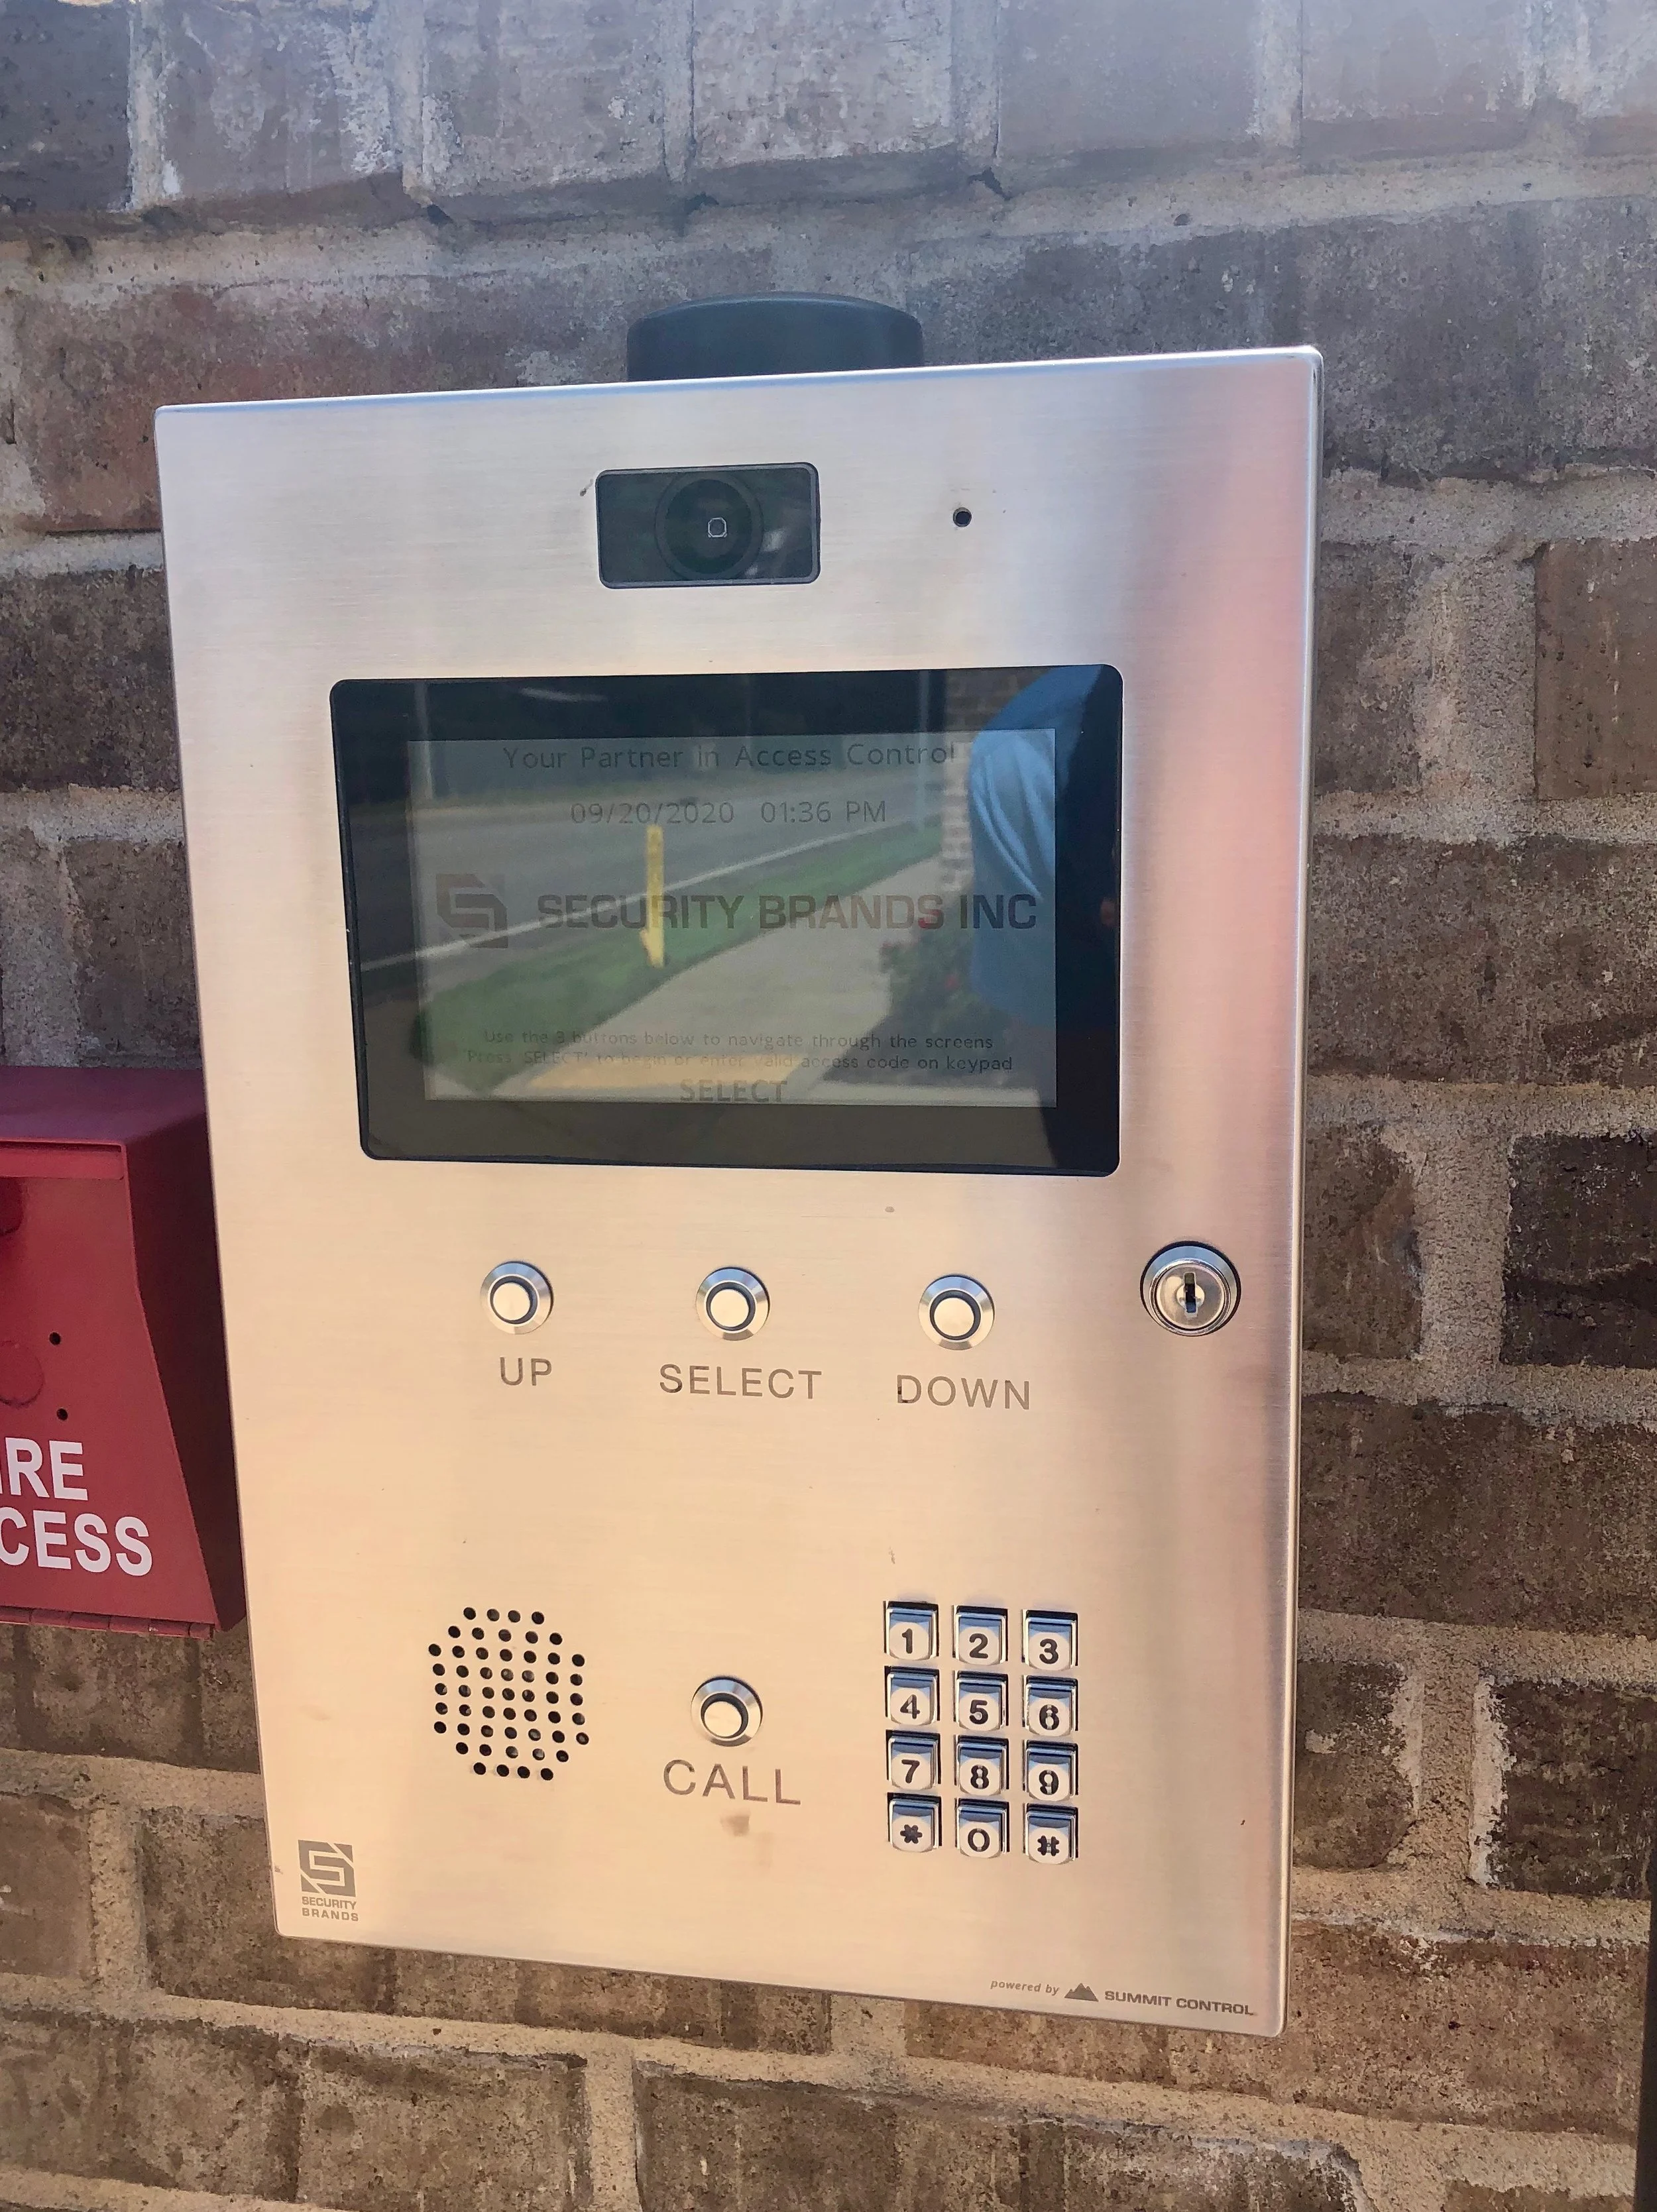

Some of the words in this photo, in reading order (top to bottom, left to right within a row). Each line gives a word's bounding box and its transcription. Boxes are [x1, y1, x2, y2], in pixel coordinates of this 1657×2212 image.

[502, 746, 568, 769] Your
[581, 746, 683, 769] Partner
[697, 744, 720, 768] in
[734, 745, 832, 767] Access
[846, 741, 955, 766] Control
[570, 801, 735, 824] 09/20/2020
[760, 801, 832, 823] 01:36
[845, 800, 886, 823] PM
[537, 894, 745, 929] SECURITY
[758, 893, 945, 929] BRANDS
[959, 893, 1037, 929] INC
[483, 1030, 514, 1044] Use
[522, 1030, 549, 1044] the
[644, 1031, 695, 1046] below
[703, 1033, 720, 1046] to
[728, 1034, 803, 1051] navigate
[812, 1033, 882, 1051] through
[889, 1034, 917, 1049] the
[925, 1036, 994, 1050] screens
[800, 1056, 859, 1069] access
[866, 1055, 910, 1070] code
[917, 1059, 939, 1070] on
[946, 1055, 1013, 1074] keypad
[679, 1078, 788, 1103] SELECT
[499, 1356, 553, 1386] UP
[659, 1362, 823, 1400] SELECT
[896, 1374, 1031, 1411] DOWN
[0, 1437, 88, 1501] RE
[901, 1628, 913, 1655] 1
[968, 1632, 989, 1659] 2
[1039, 1637, 1059, 1665] 3
[899, 1694, 921, 1720] 4
[969, 1699, 989, 1725] 5
[1039, 1704, 1060, 1730] 6
[663, 1759, 801, 1805] CALL
[901, 1759, 920, 1784] 7
[970, 1763, 990, 1789] 8
[1039, 1769, 1059, 1796] 9
[967, 1827, 990, 1852] 0
[302, 1896, 357, 1910] SECURITY
[302, 1907, 359, 1922] BRANDS
[990, 1979, 1042, 1993] powered
[1045, 1983, 1060, 1996] by
[1104, 1989, 1172, 2007] SUMMIT
[1176, 1997, 1255, 2016] CONTROL
